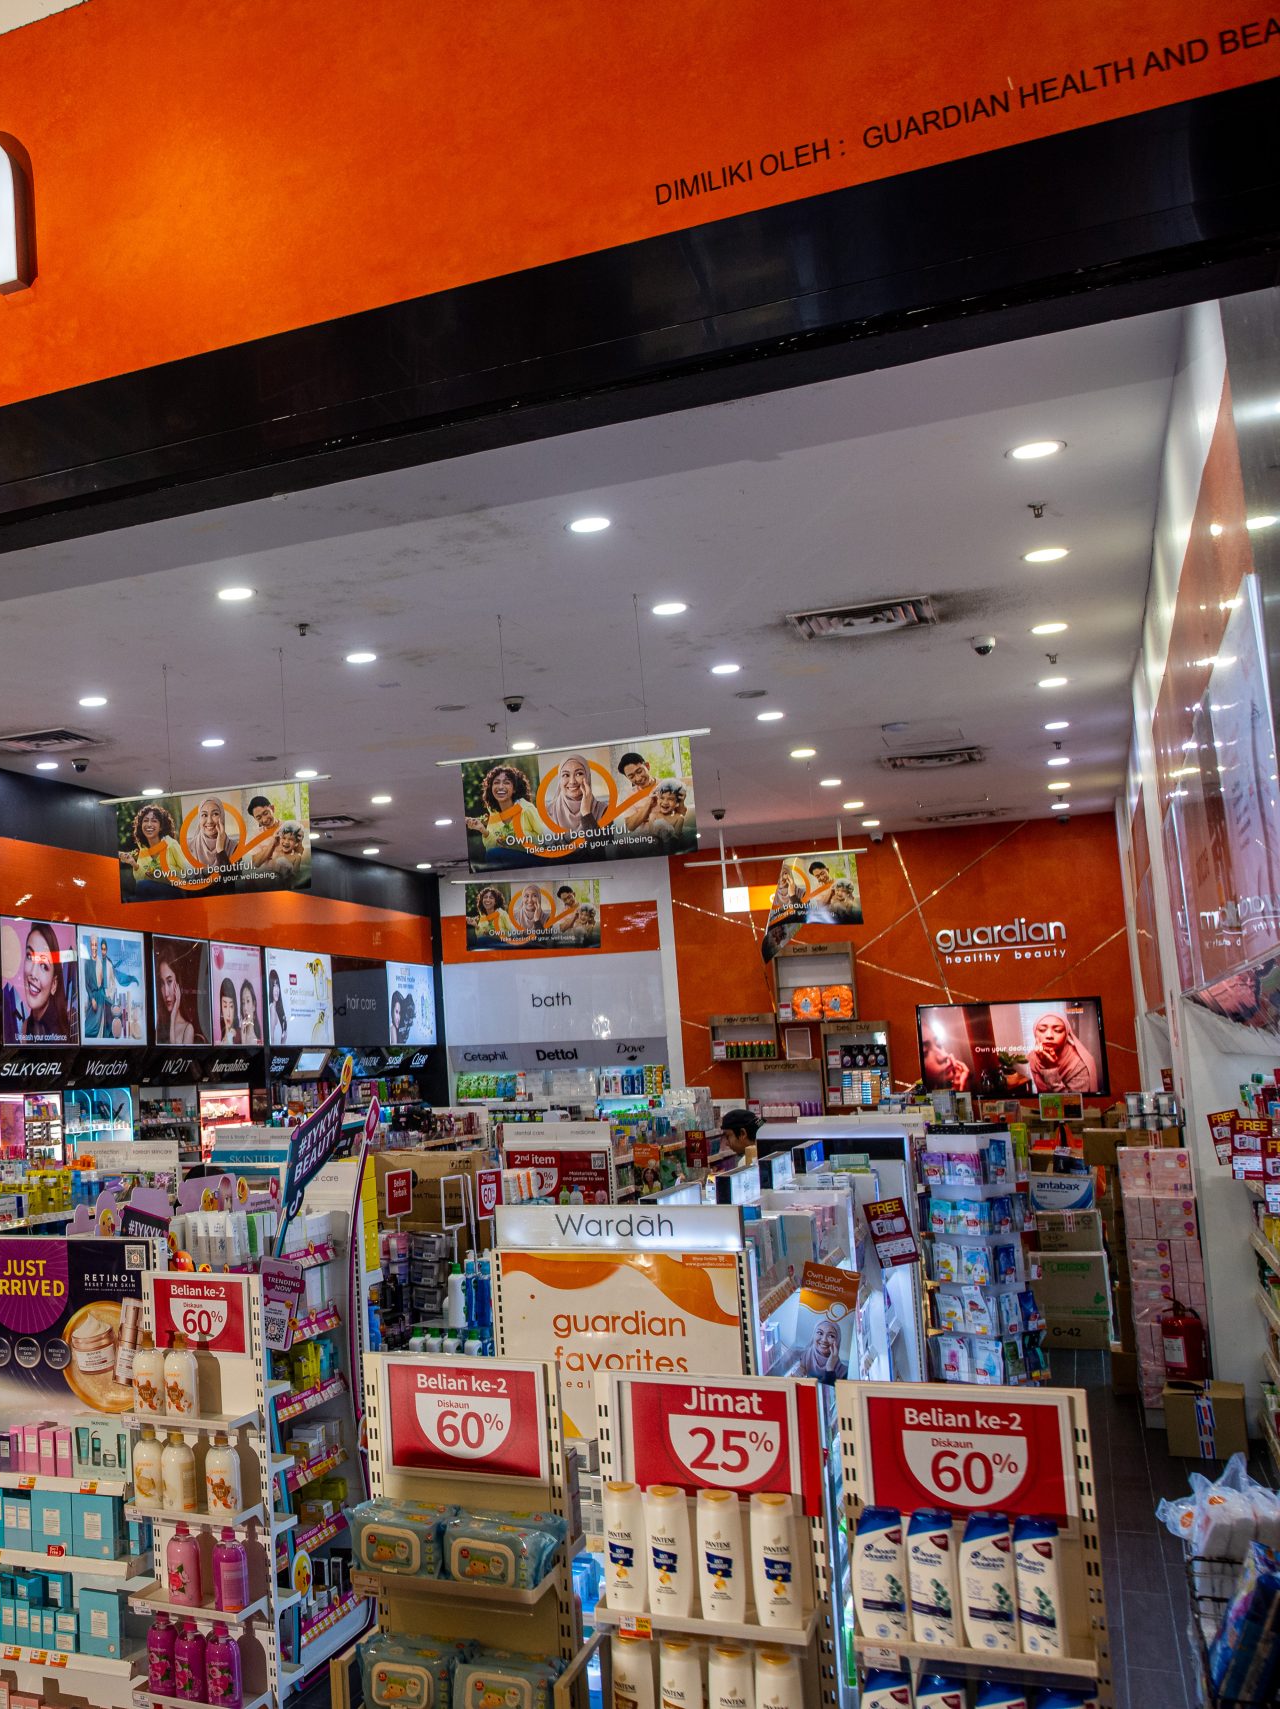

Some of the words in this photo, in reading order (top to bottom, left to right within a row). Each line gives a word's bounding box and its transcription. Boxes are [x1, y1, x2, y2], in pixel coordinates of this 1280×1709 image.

[655, 159, 753, 206] DIMILIKI
[760, 138, 831, 176] OLEH
[863, 91, 1010, 149] GUARDIAN
[1019, 57, 1136, 109] HEALTH
[1143, 38, 1210, 77] AND
[506, 834, 533, 846] Own
[537, 832, 566, 845] your
[569, 823, 631, 839] beautiful.
[525, 846, 545, 855] Take
[546, 842, 577, 853] control
[578, 841, 588, 850] of
[589, 840, 609, 850] your
[611, 834, 656, 846] wellbeing.
[153, 868, 177, 879] Own
[180, 866, 205, 879] your
[207, 861, 256, 874] beautiful.
[170, 879, 187, 888] Take
[188, 876, 214, 886] control
[214, 875, 222, 883] of
[222, 874, 239, 884] your
[240, 870, 277, 880] wellbeing.
[935, 917, 1067, 954] guardian
[792, 945, 808, 953] best
[811, 944, 828, 952] seller
[945, 952, 1000, 965] healthy
[1014, 947, 1067, 960] beauty
[346, 993, 360, 1010] hair
[361, 997, 377, 1010] care
[531, 991, 572, 1008] bath
[739, 1015, 760, 1023] arrival
[33, 1034, 43, 1043] your
[43, 1033, 67, 1042] confidence
[463, 1051, 508, 1063] Cetaphil
[536, 1048, 579, 1062] Dettol
[616, 1042, 645, 1054] Dove
[991, 1046, 1007, 1054] your
[0, 1062, 63, 1077] SILKYGIRL
[763, 1062, 799, 1071] promotion
[1235, 1120, 1269, 1132] FREE
[294, 1122, 339, 1183] BEAUTY
[514, 1153, 530, 1165] 2nd
[531, 1153, 556, 1165] item
[393, 1178, 406, 1188] Belian
[1036, 1180, 1080, 1191] antabax
[868, 1200, 902, 1217] FREE
[3, 1259, 47, 1277] JUST
[84, 1273, 136, 1282] RETINOL
[267, 1276, 301, 1288] TRENDING
[806, 1270, 824, 1279] Own
[824, 1275, 842, 1285] your
[170, 1284, 203, 1297] Belian
[203, 1286, 226, 1299] ke-2
[274, 1284, 293, 1294] NOW
[182, 1308, 224, 1336] 60%
[552, 1310, 687, 1339] guardian
[1051, 1327, 1082, 1338] G-42
[554, 1345, 689, 1373] favorites
[416, 1373, 468, 1391] Belian
[471, 1376, 508, 1394] ke-2
[437, 1400, 470, 1409] Diskaun
[683, 1386, 764, 1415] Jimat
[903, 1406, 971, 1429] Belian
[974, 1409, 1024, 1431] ke-2
[436, 1409, 504, 1449] 60%
[688, 1426, 774, 1474] 25%
[930, 1437, 974, 1450] Diskaun
[930, 1449, 1019, 1495] 60%
[607, 1530, 632, 1540] PANTENE
[651, 1535, 676, 1545] PANTENE
[705, 1540, 732, 1549] PANTENE
[762, 1545, 791, 1554] PANTENE
[661, 1687, 685, 1698] PANTENE
[720, 1696, 747, 1706] PANTENE
